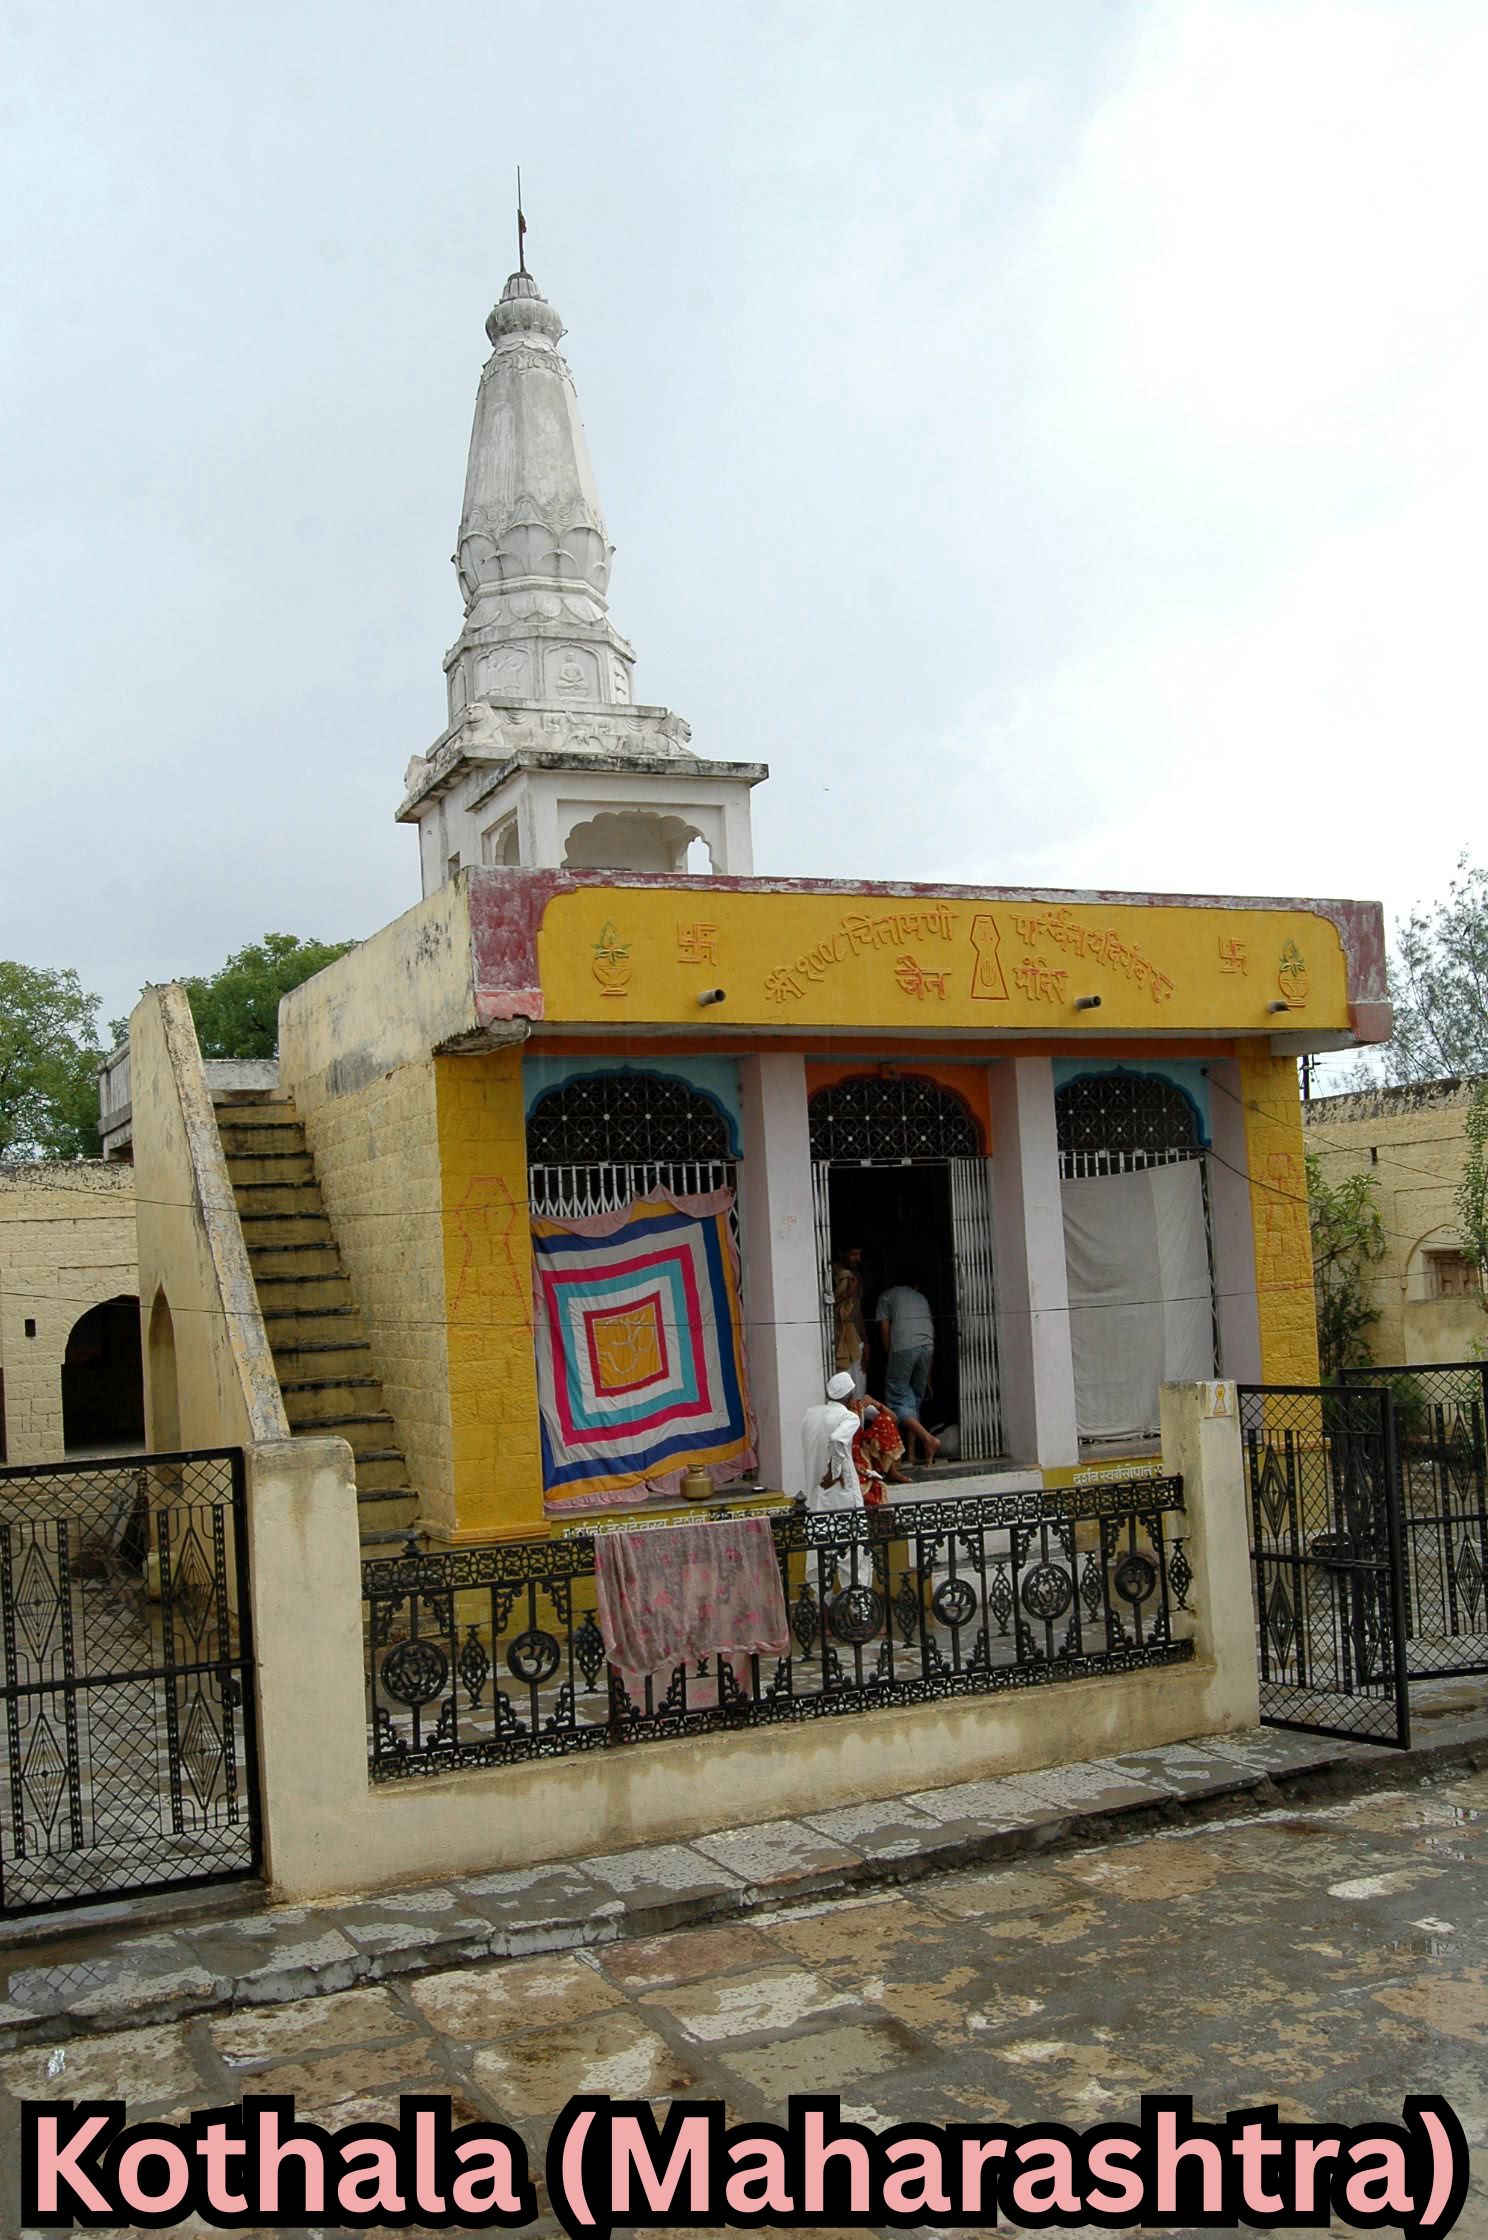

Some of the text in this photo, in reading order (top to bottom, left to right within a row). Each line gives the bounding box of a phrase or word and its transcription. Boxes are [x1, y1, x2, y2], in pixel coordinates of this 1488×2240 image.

[763, 965, 807, 1004] श्री
[894, 953, 1069, 1003] जैन मंदिर
